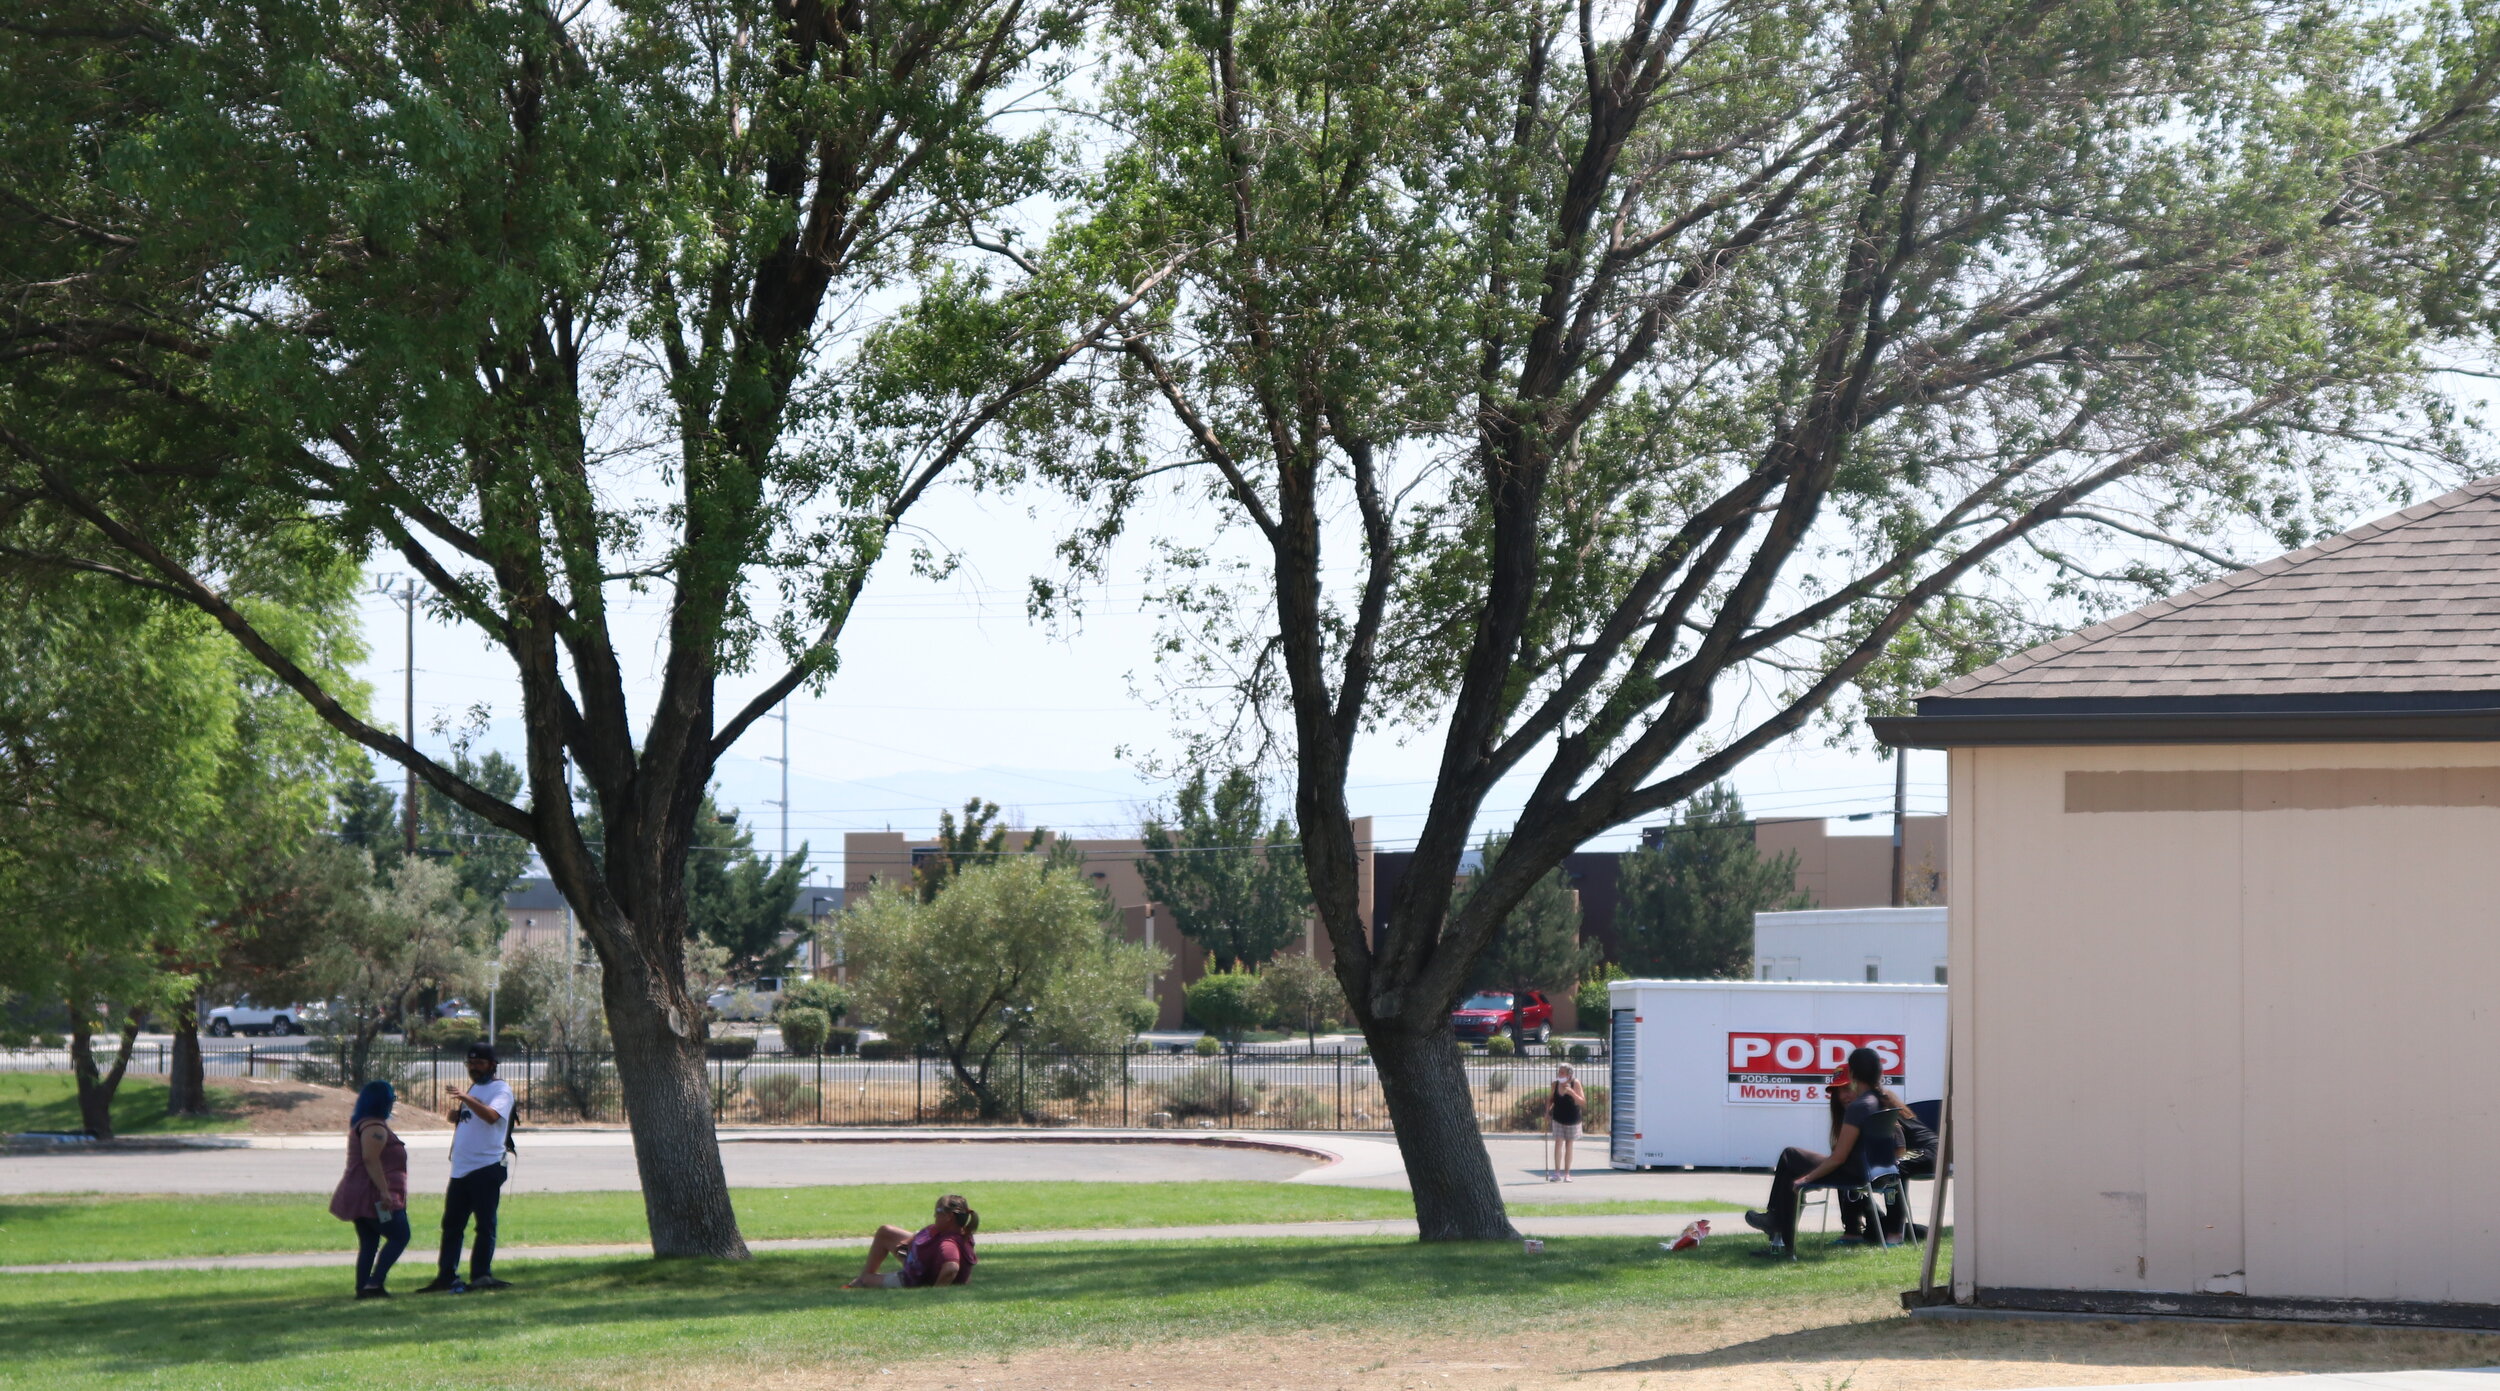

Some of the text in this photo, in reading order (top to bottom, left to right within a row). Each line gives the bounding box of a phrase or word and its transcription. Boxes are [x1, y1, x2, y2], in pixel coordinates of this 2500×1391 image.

[1733, 1038, 1900, 1070] PODS
[1740, 1075, 1792, 1084] PODS.com
[1740, 1085, 1801, 1102] Moving
[1806, 1086, 1819, 1099] &
